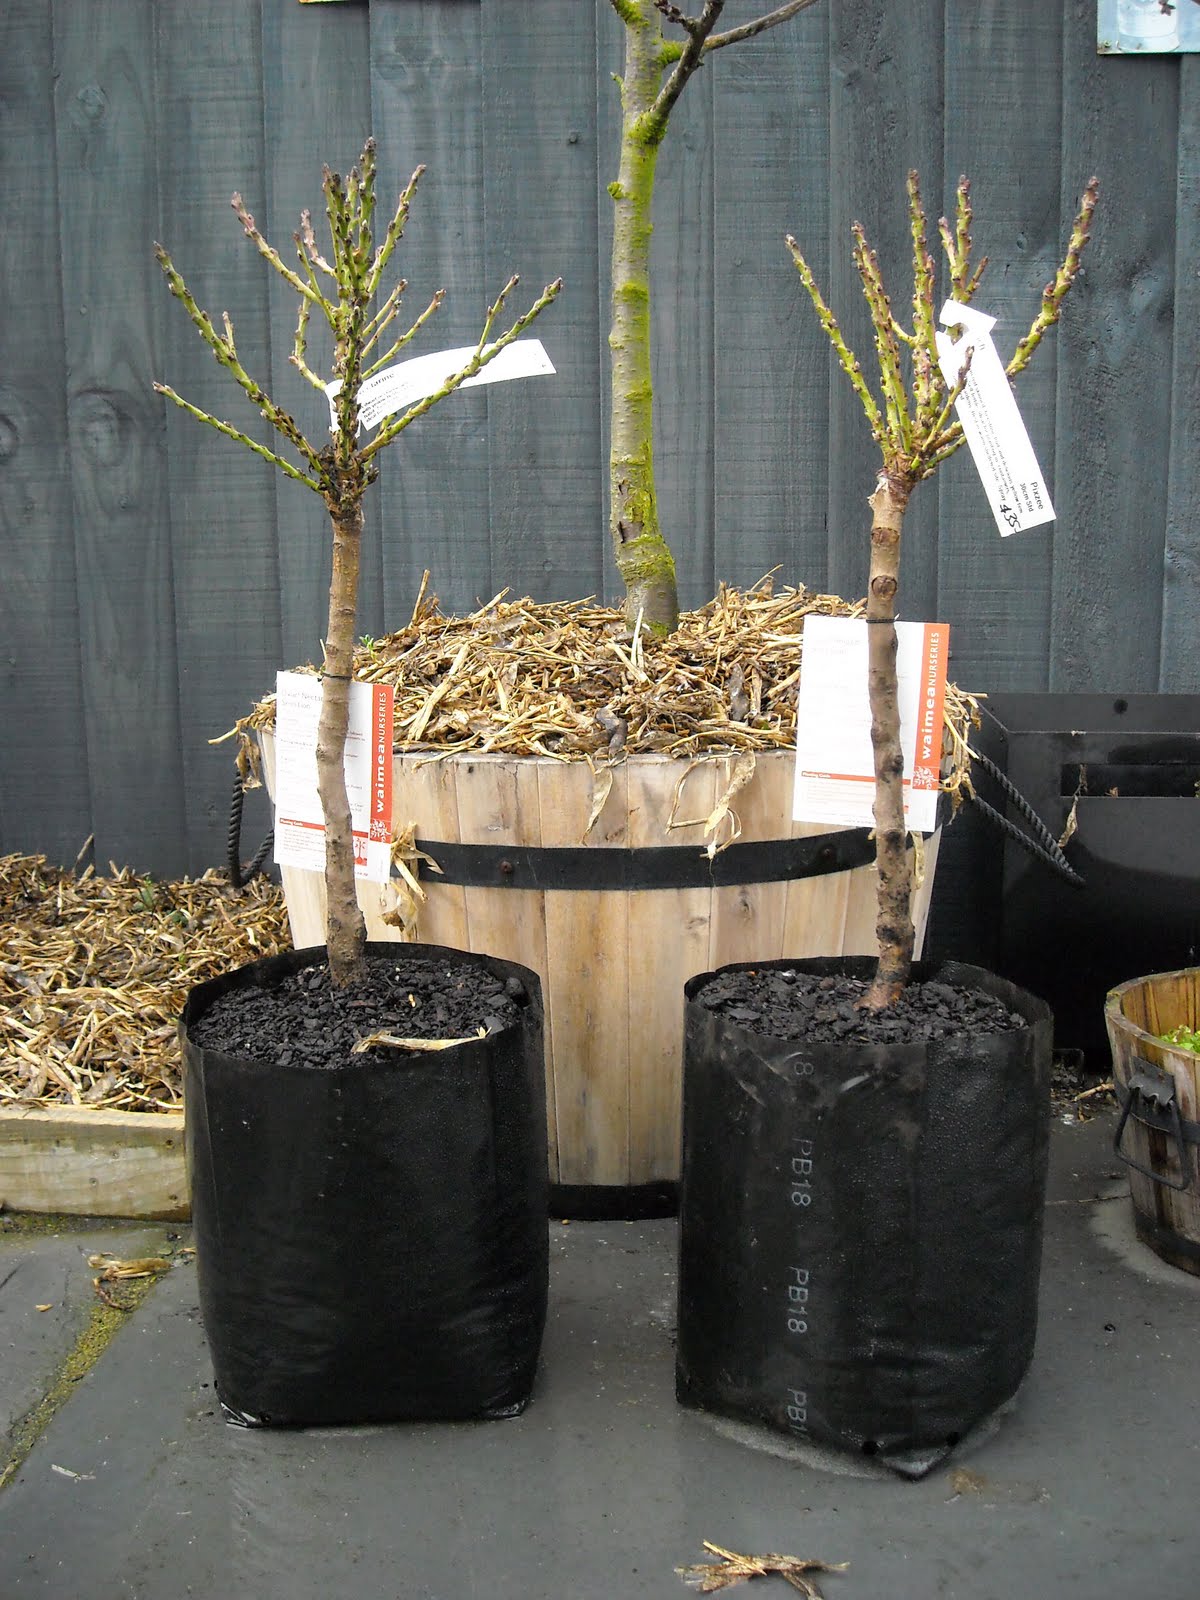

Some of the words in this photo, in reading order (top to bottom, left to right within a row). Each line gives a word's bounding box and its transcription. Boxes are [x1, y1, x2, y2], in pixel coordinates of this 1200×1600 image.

[1030, 481, 1045, 510] Pixzee
[792, 1138, 814, 1206] PB18
[787, 1266, 809, 1334] PB18
